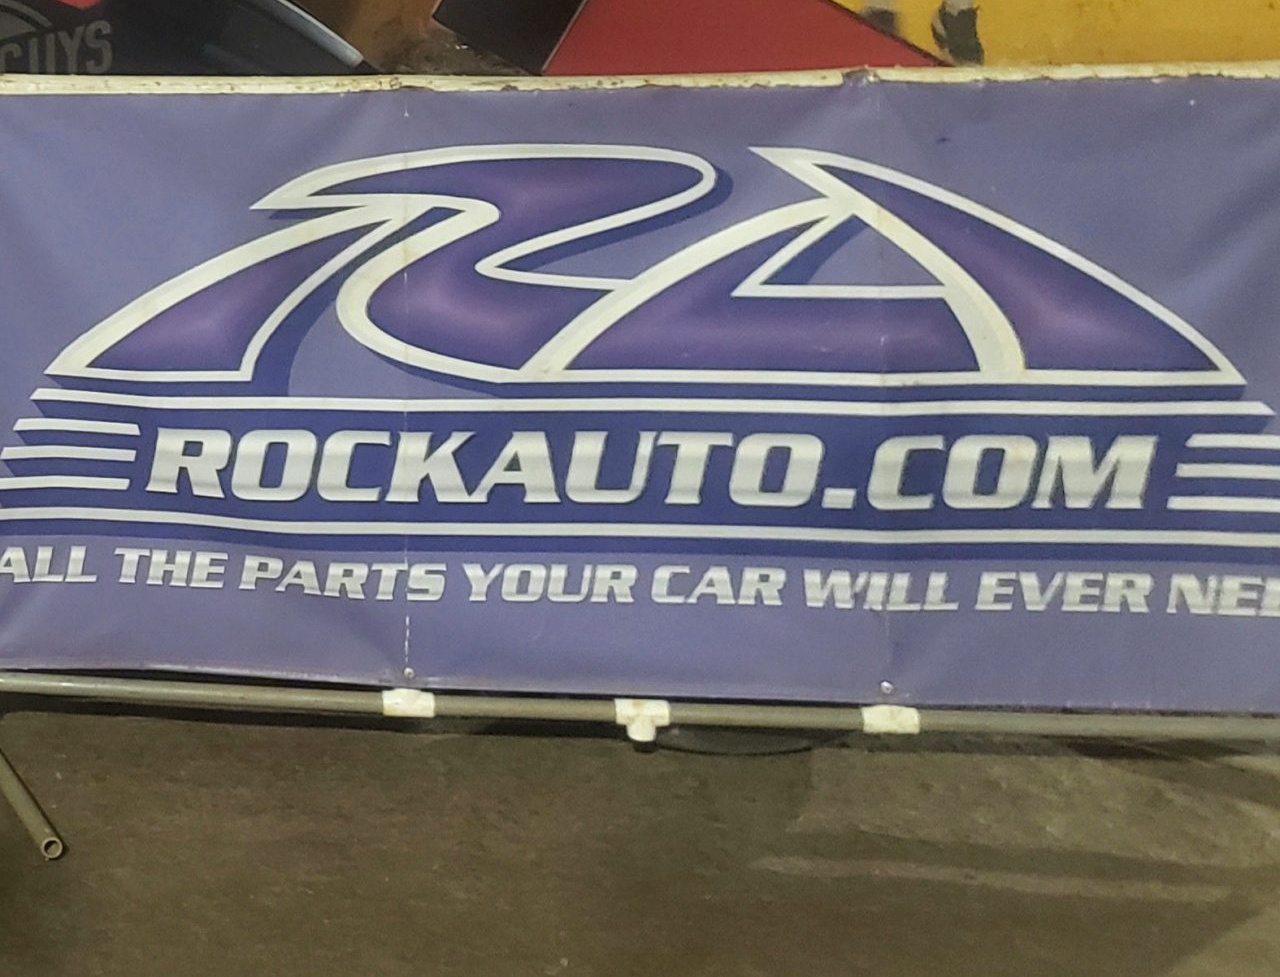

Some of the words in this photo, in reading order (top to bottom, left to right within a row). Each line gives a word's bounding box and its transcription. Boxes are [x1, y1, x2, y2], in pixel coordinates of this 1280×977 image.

[145, 427, 1159, 511] ROCKAUTO.COM
[114, 547, 229, 589] THE
[238, 554, 448, 602] PARTS
[463, 563, 637, 604] YOUR
[650, 564, 787, 606] CAR
[803, 570, 960, 612] WILL
[974, 571, 1153, 614] EVER
